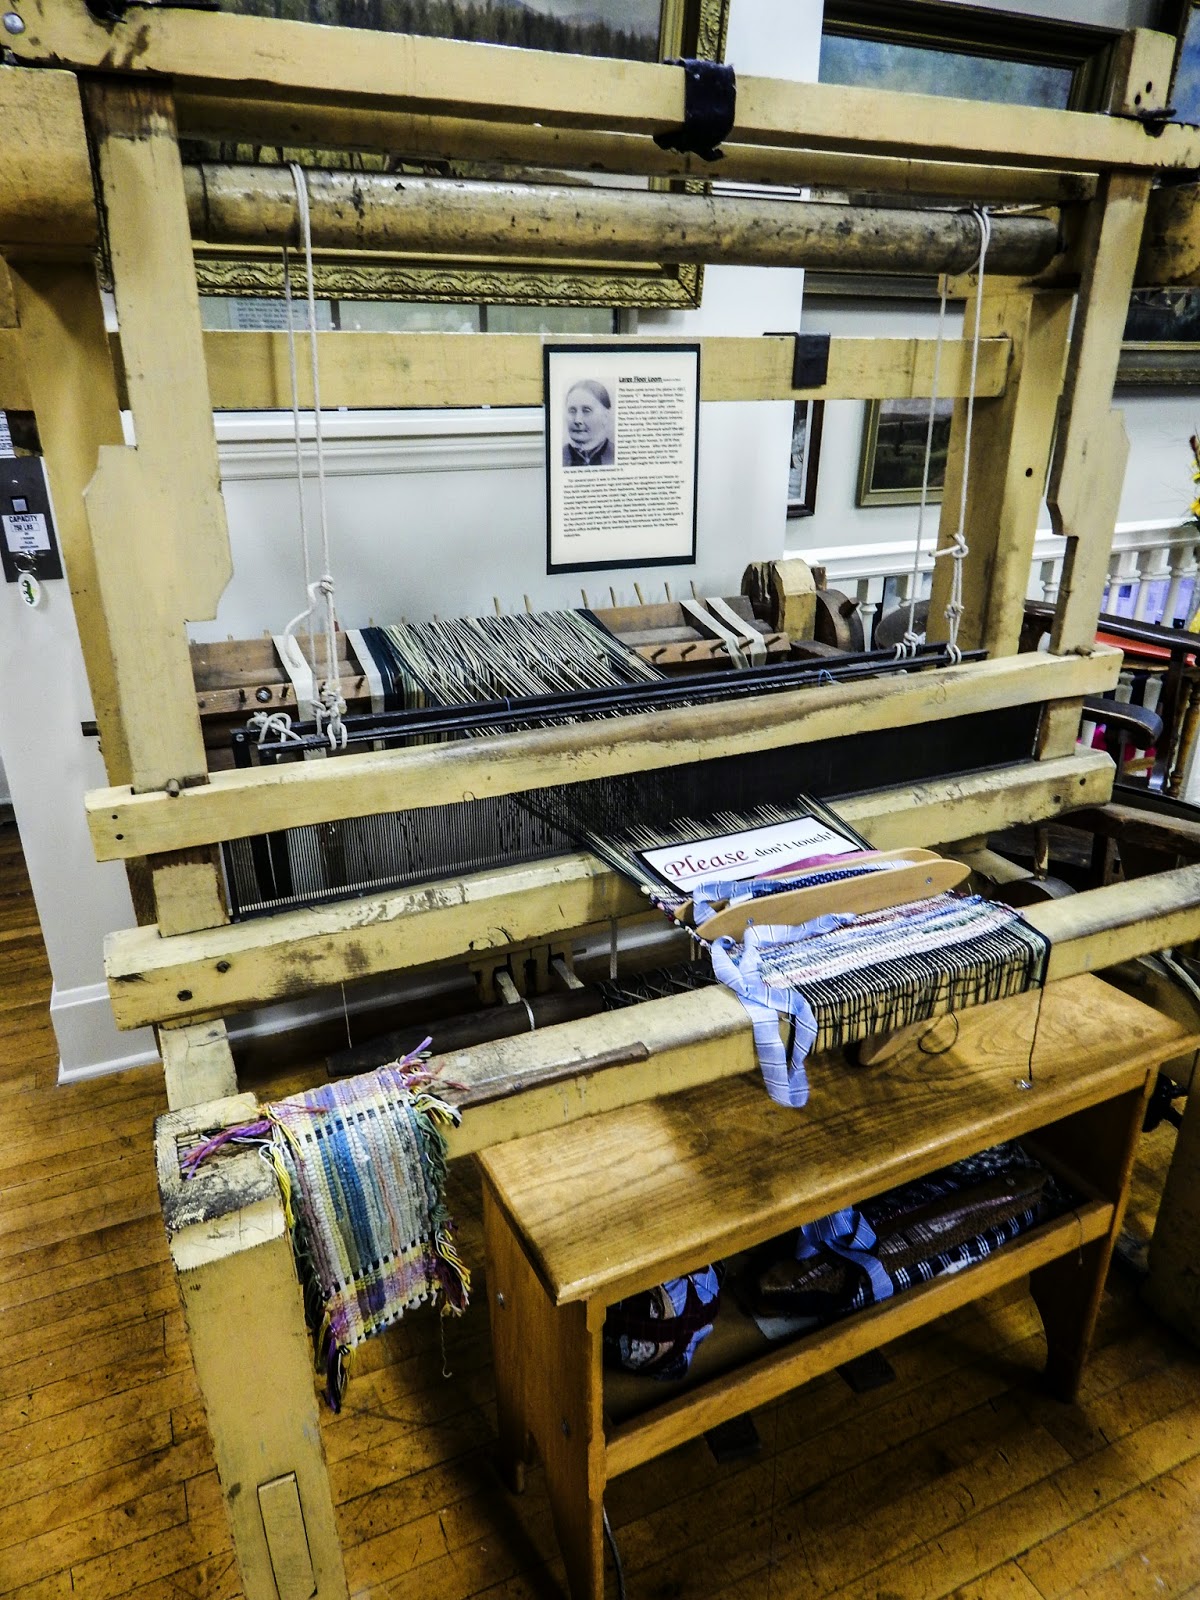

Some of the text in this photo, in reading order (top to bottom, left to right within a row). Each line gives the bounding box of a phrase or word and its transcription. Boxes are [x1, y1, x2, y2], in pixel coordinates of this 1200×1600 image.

[9, 515, 38, 523] CAPACITY
[663, 831, 836, 877] Please don't touch!
